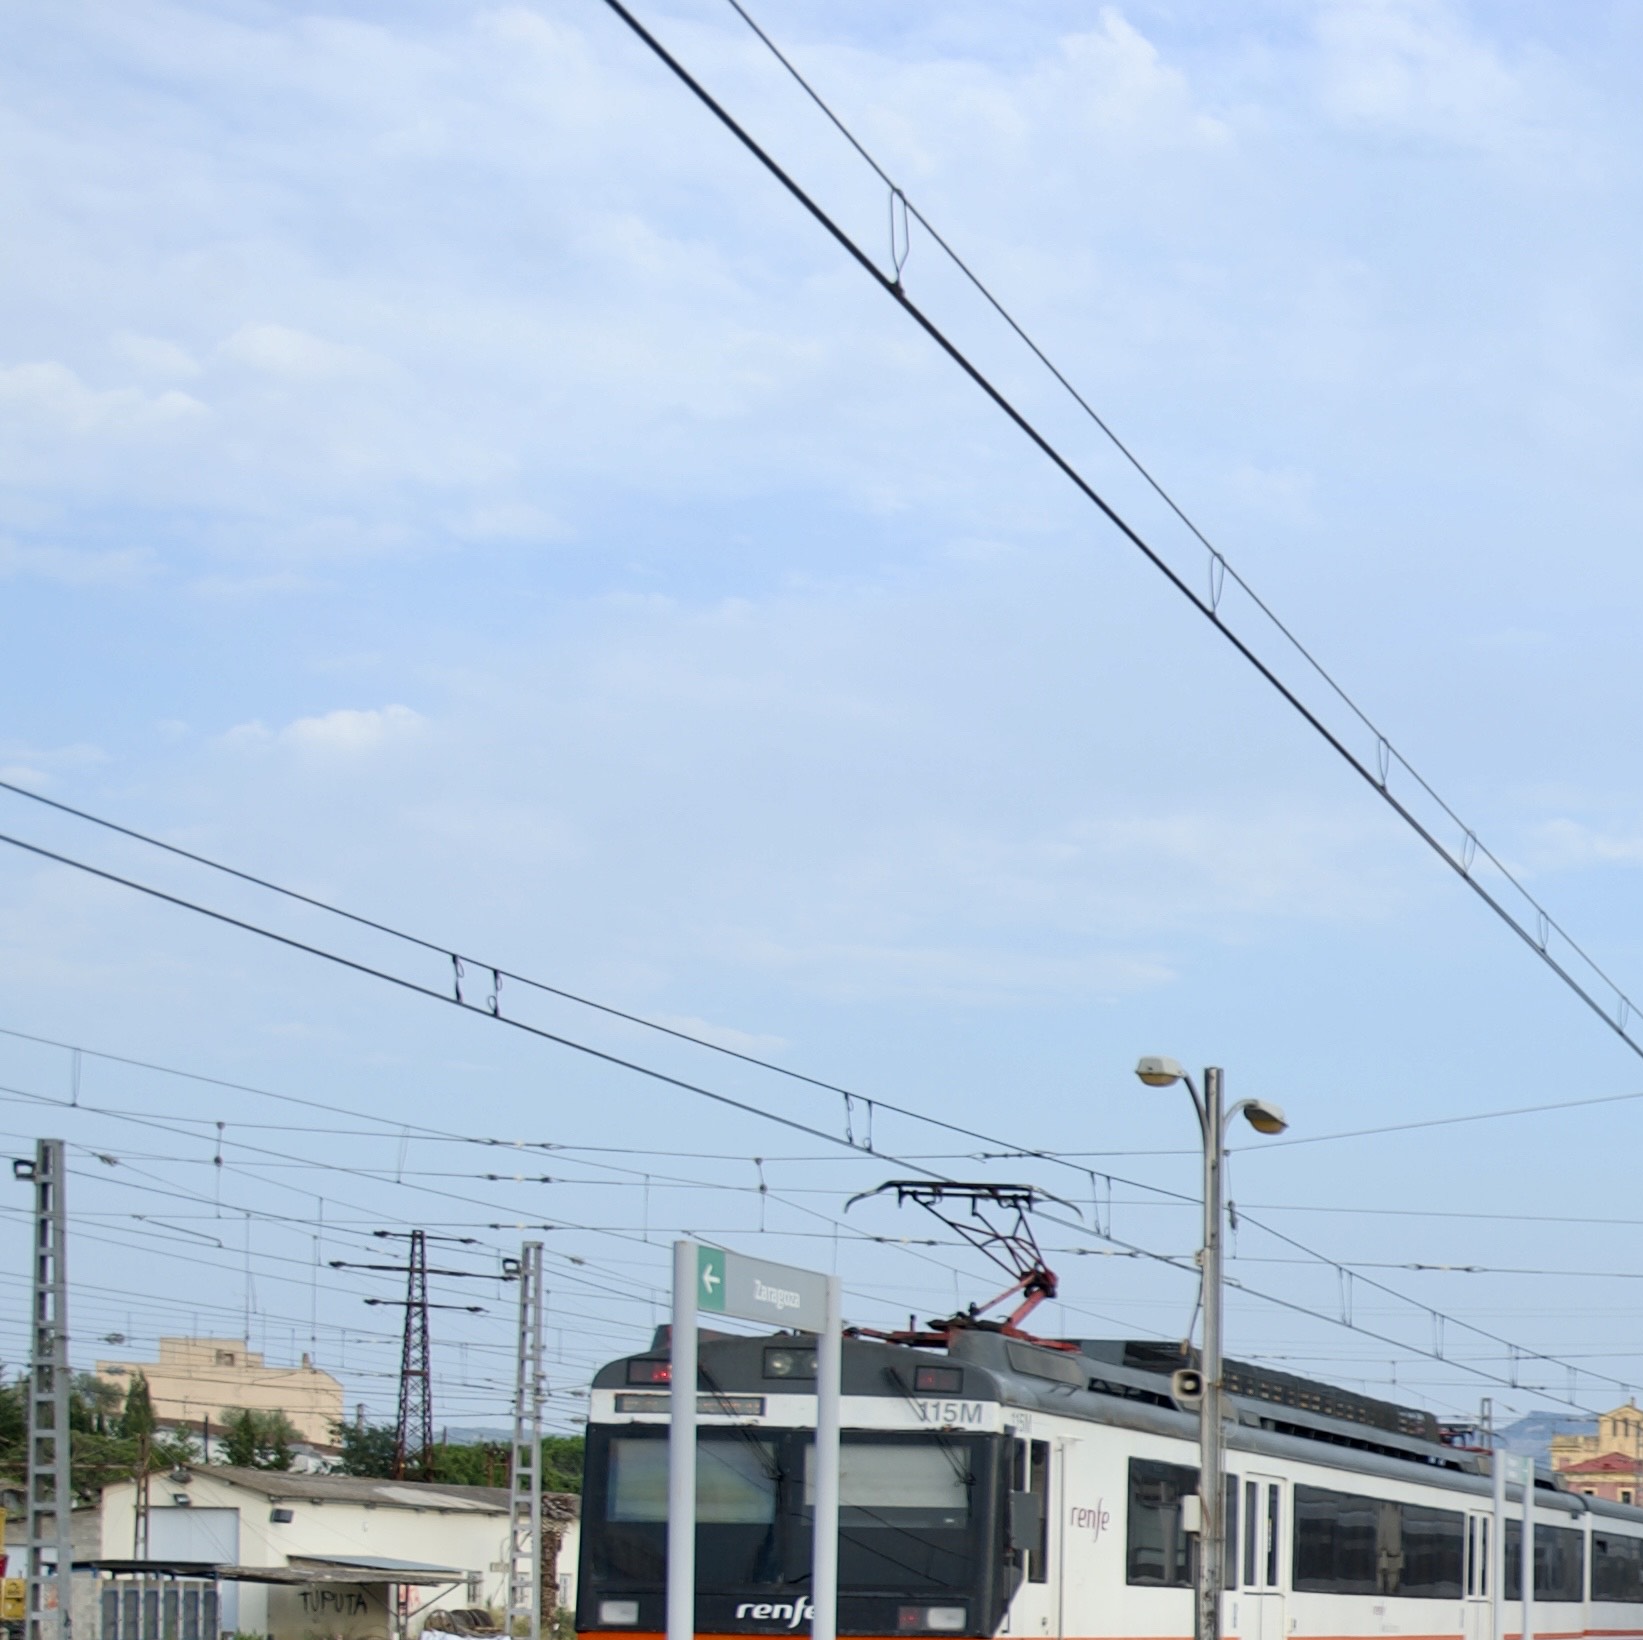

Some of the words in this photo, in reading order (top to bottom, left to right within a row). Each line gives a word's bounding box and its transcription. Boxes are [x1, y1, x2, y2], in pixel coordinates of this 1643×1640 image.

[754, 1278, 801, 1310] Zaragoza
[920, 1400, 984, 1425] 115M
[1070, 1496, 1111, 1544] renfe
[298, 1589, 368, 1616] TUPUTA
